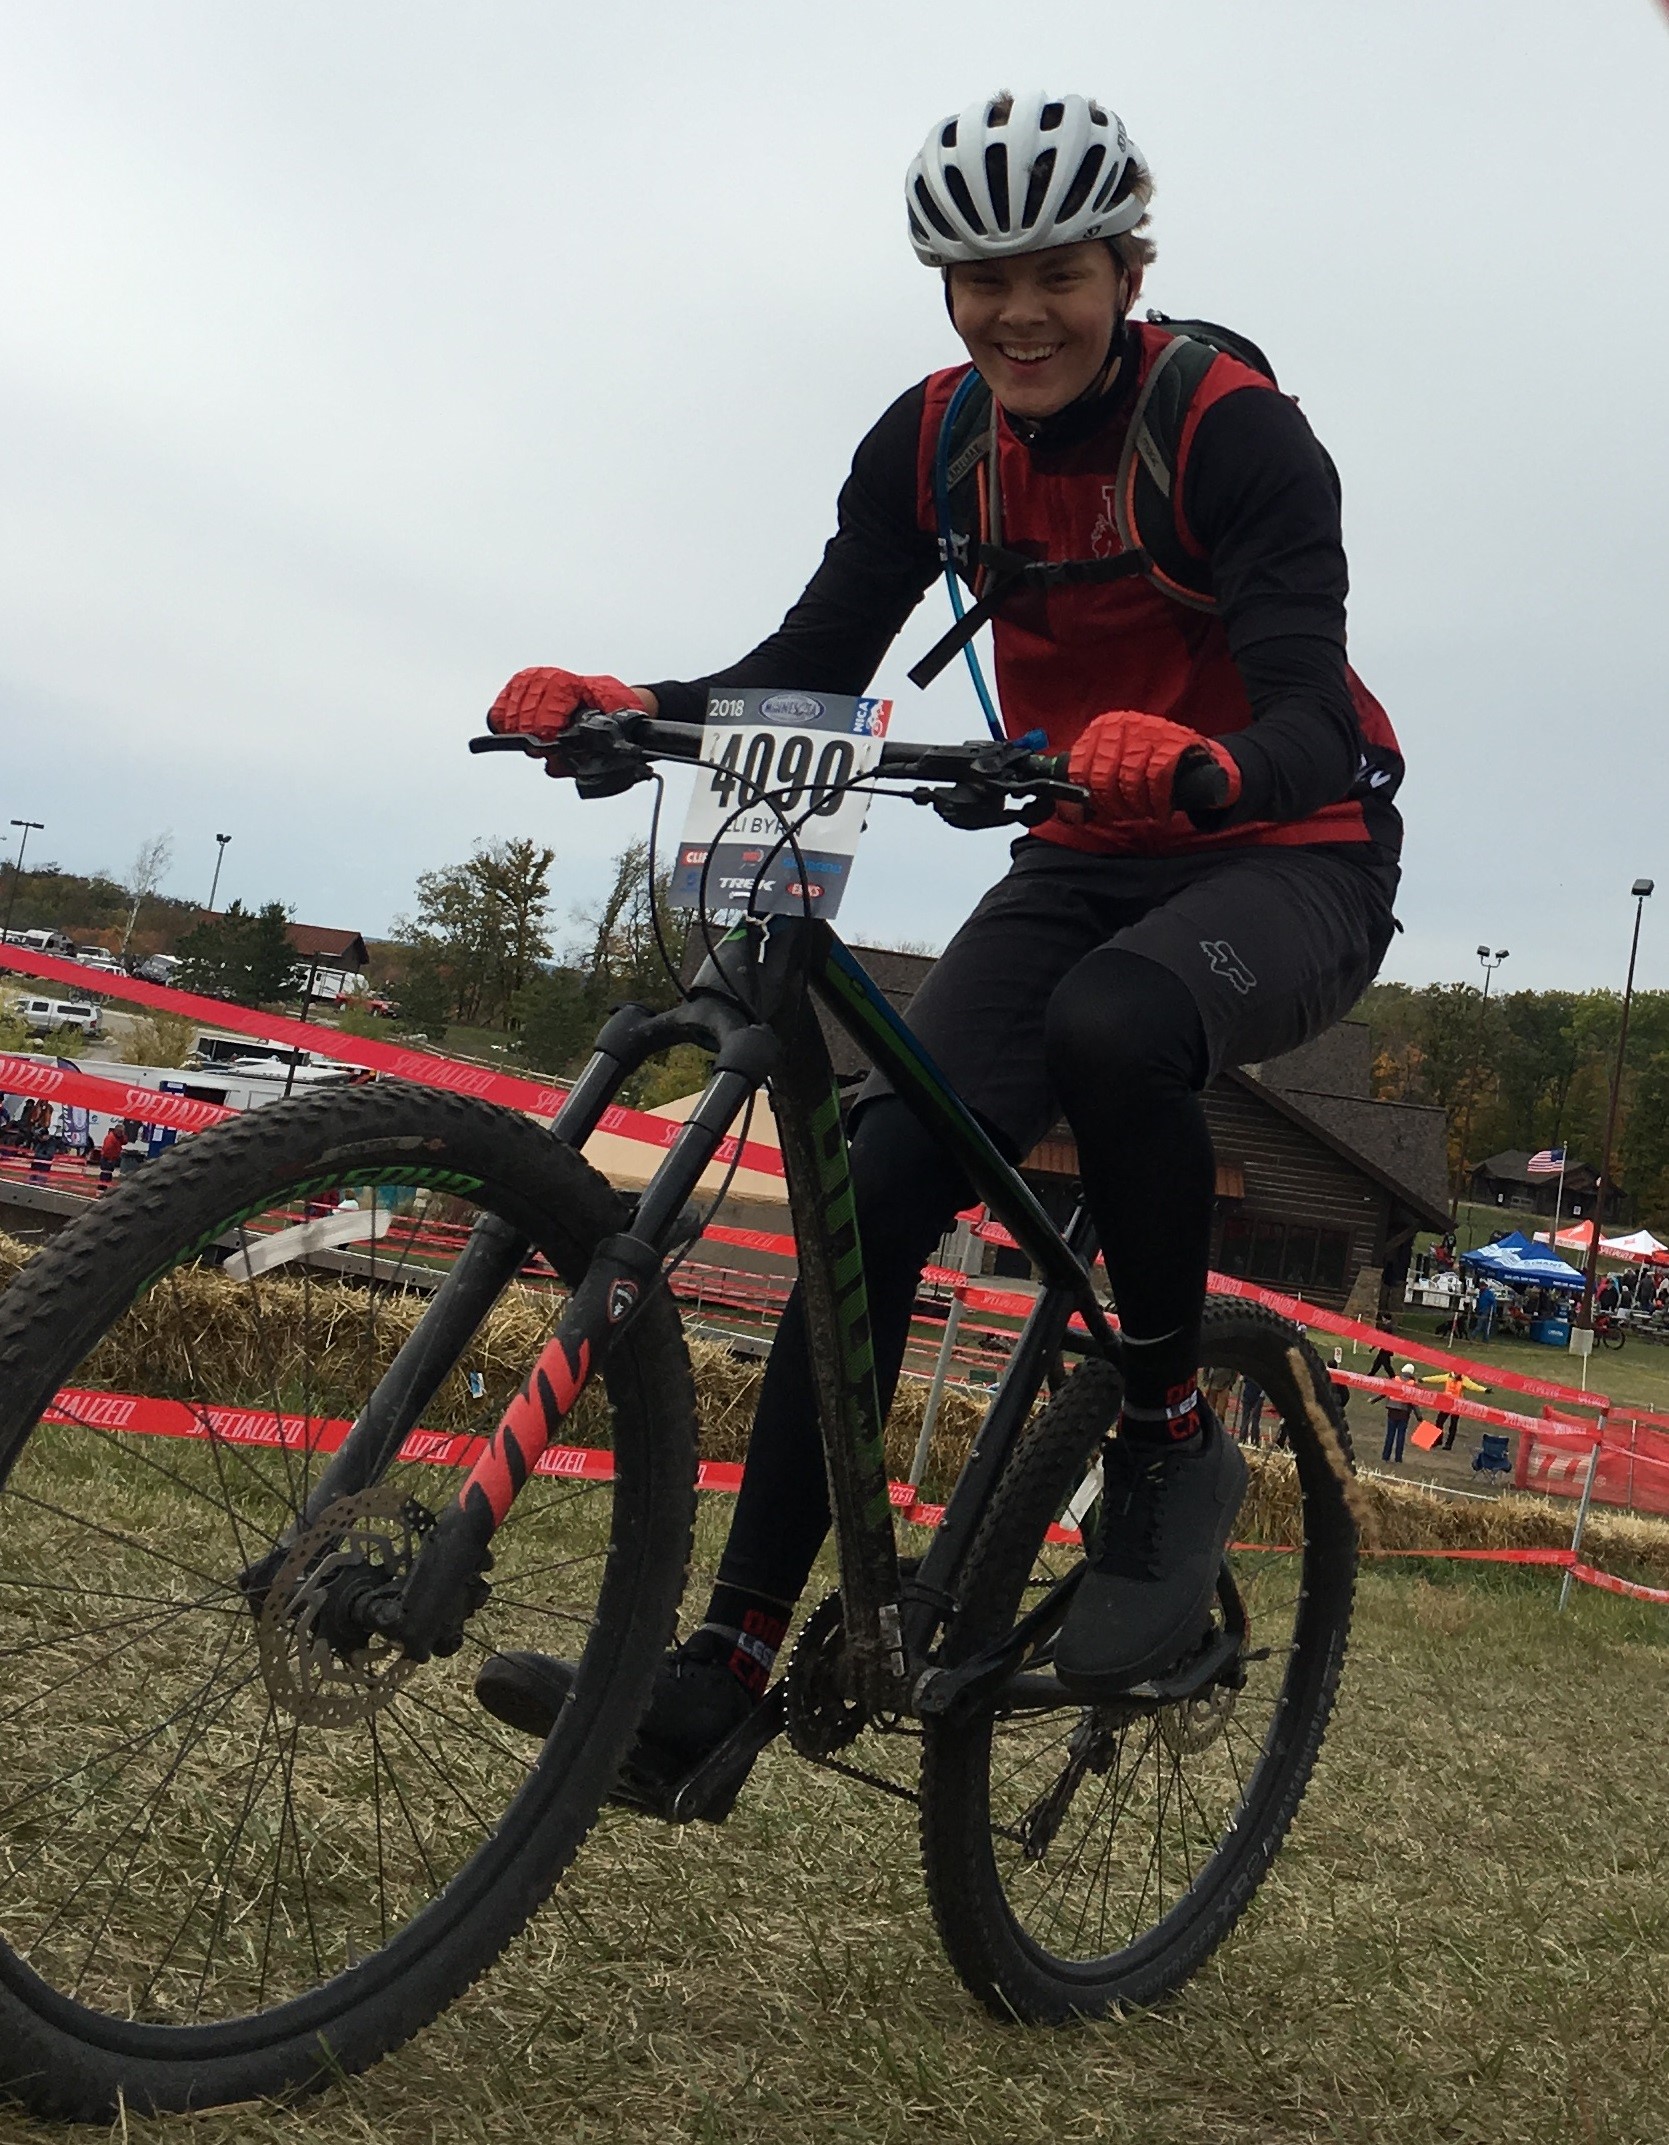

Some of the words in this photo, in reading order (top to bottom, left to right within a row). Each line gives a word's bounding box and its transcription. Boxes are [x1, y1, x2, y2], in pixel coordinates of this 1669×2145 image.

[709, 699, 745, 717] 2018
[853, 701, 869, 732] NICA
[710, 733, 854, 817] 4090
[719, 877, 776, 892] TREK
[391, 1054, 496, 1094] SPECIALIZED
[114, 1089, 241, 1127] SPECIALIZE
[186, 1409, 305, 1444] SPECIALIZED
